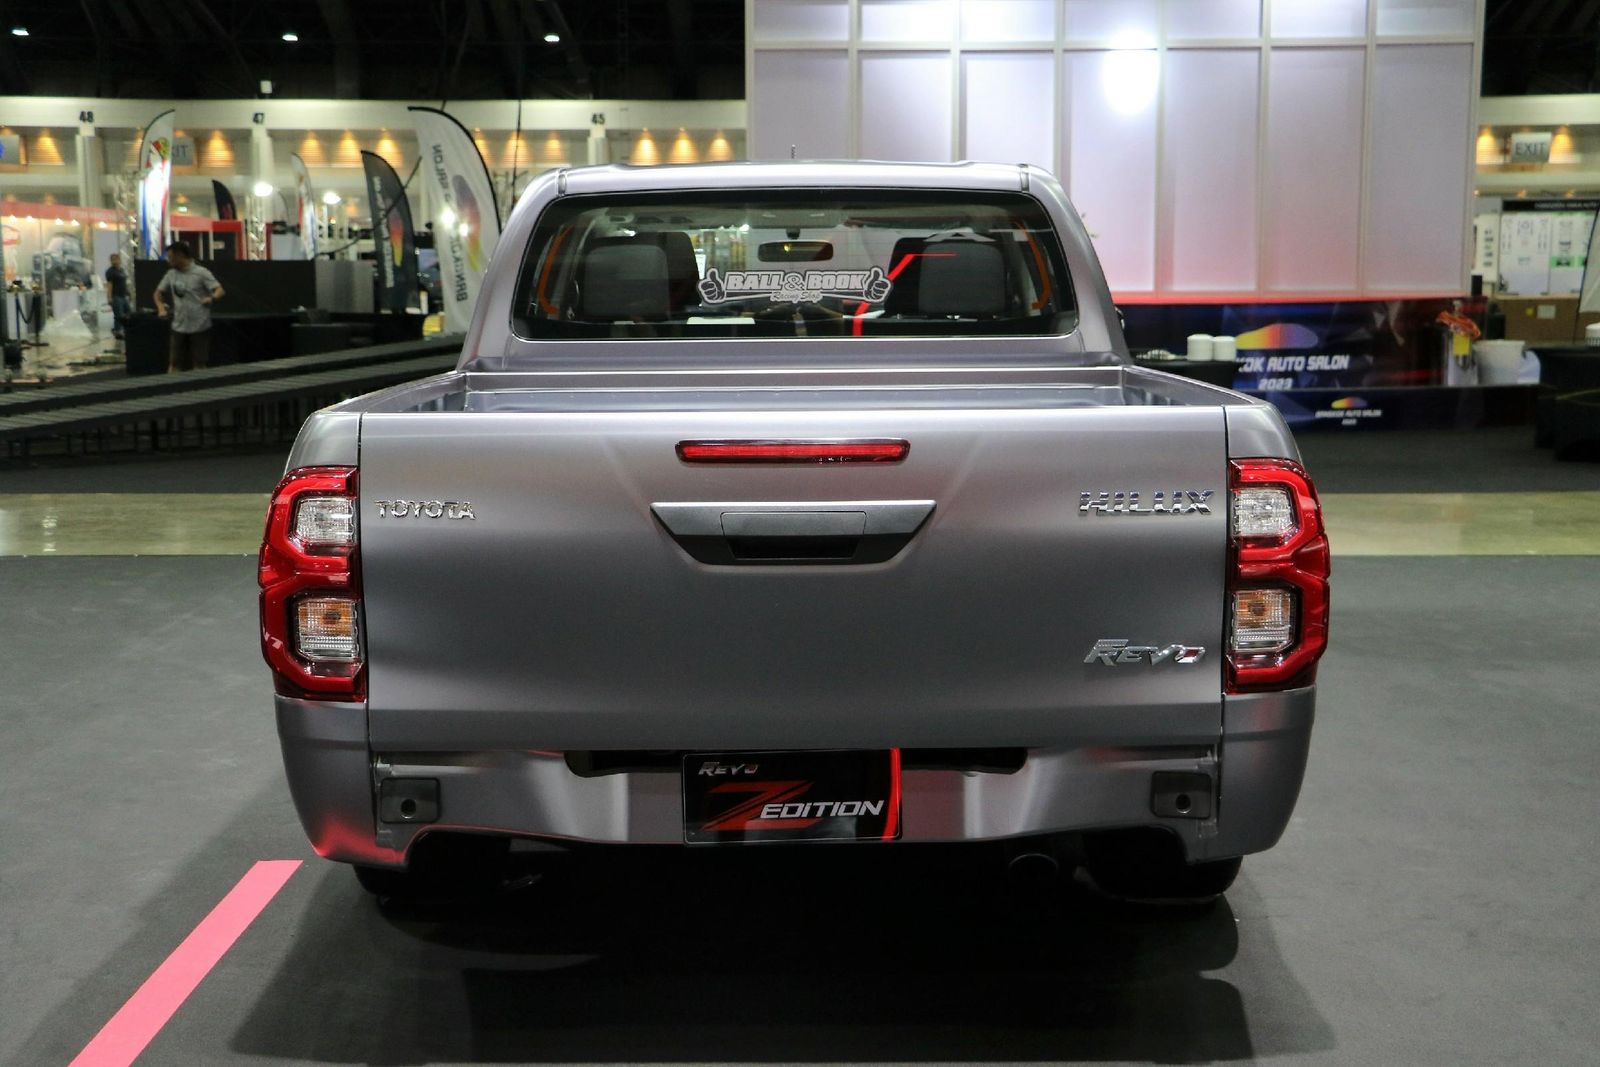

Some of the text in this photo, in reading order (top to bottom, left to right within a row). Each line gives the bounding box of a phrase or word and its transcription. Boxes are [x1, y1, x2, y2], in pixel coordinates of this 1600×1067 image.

[79, 110, 94, 123] 48
[252, 112, 265, 125] 47
[591, 113, 606, 125] 45
[1515, 141, 1546, 156] EXIT
[725, 272, 866, 291] BALL & BOOK
[1266, 356, 1305, 372] AUTO
[1306, 354, 1350, 371] SALON
[374, 499, 476, 520] TOYOTA
[1079, 490, 1215, 514] HILUX
[759, 800, 885, 819] EDITION
